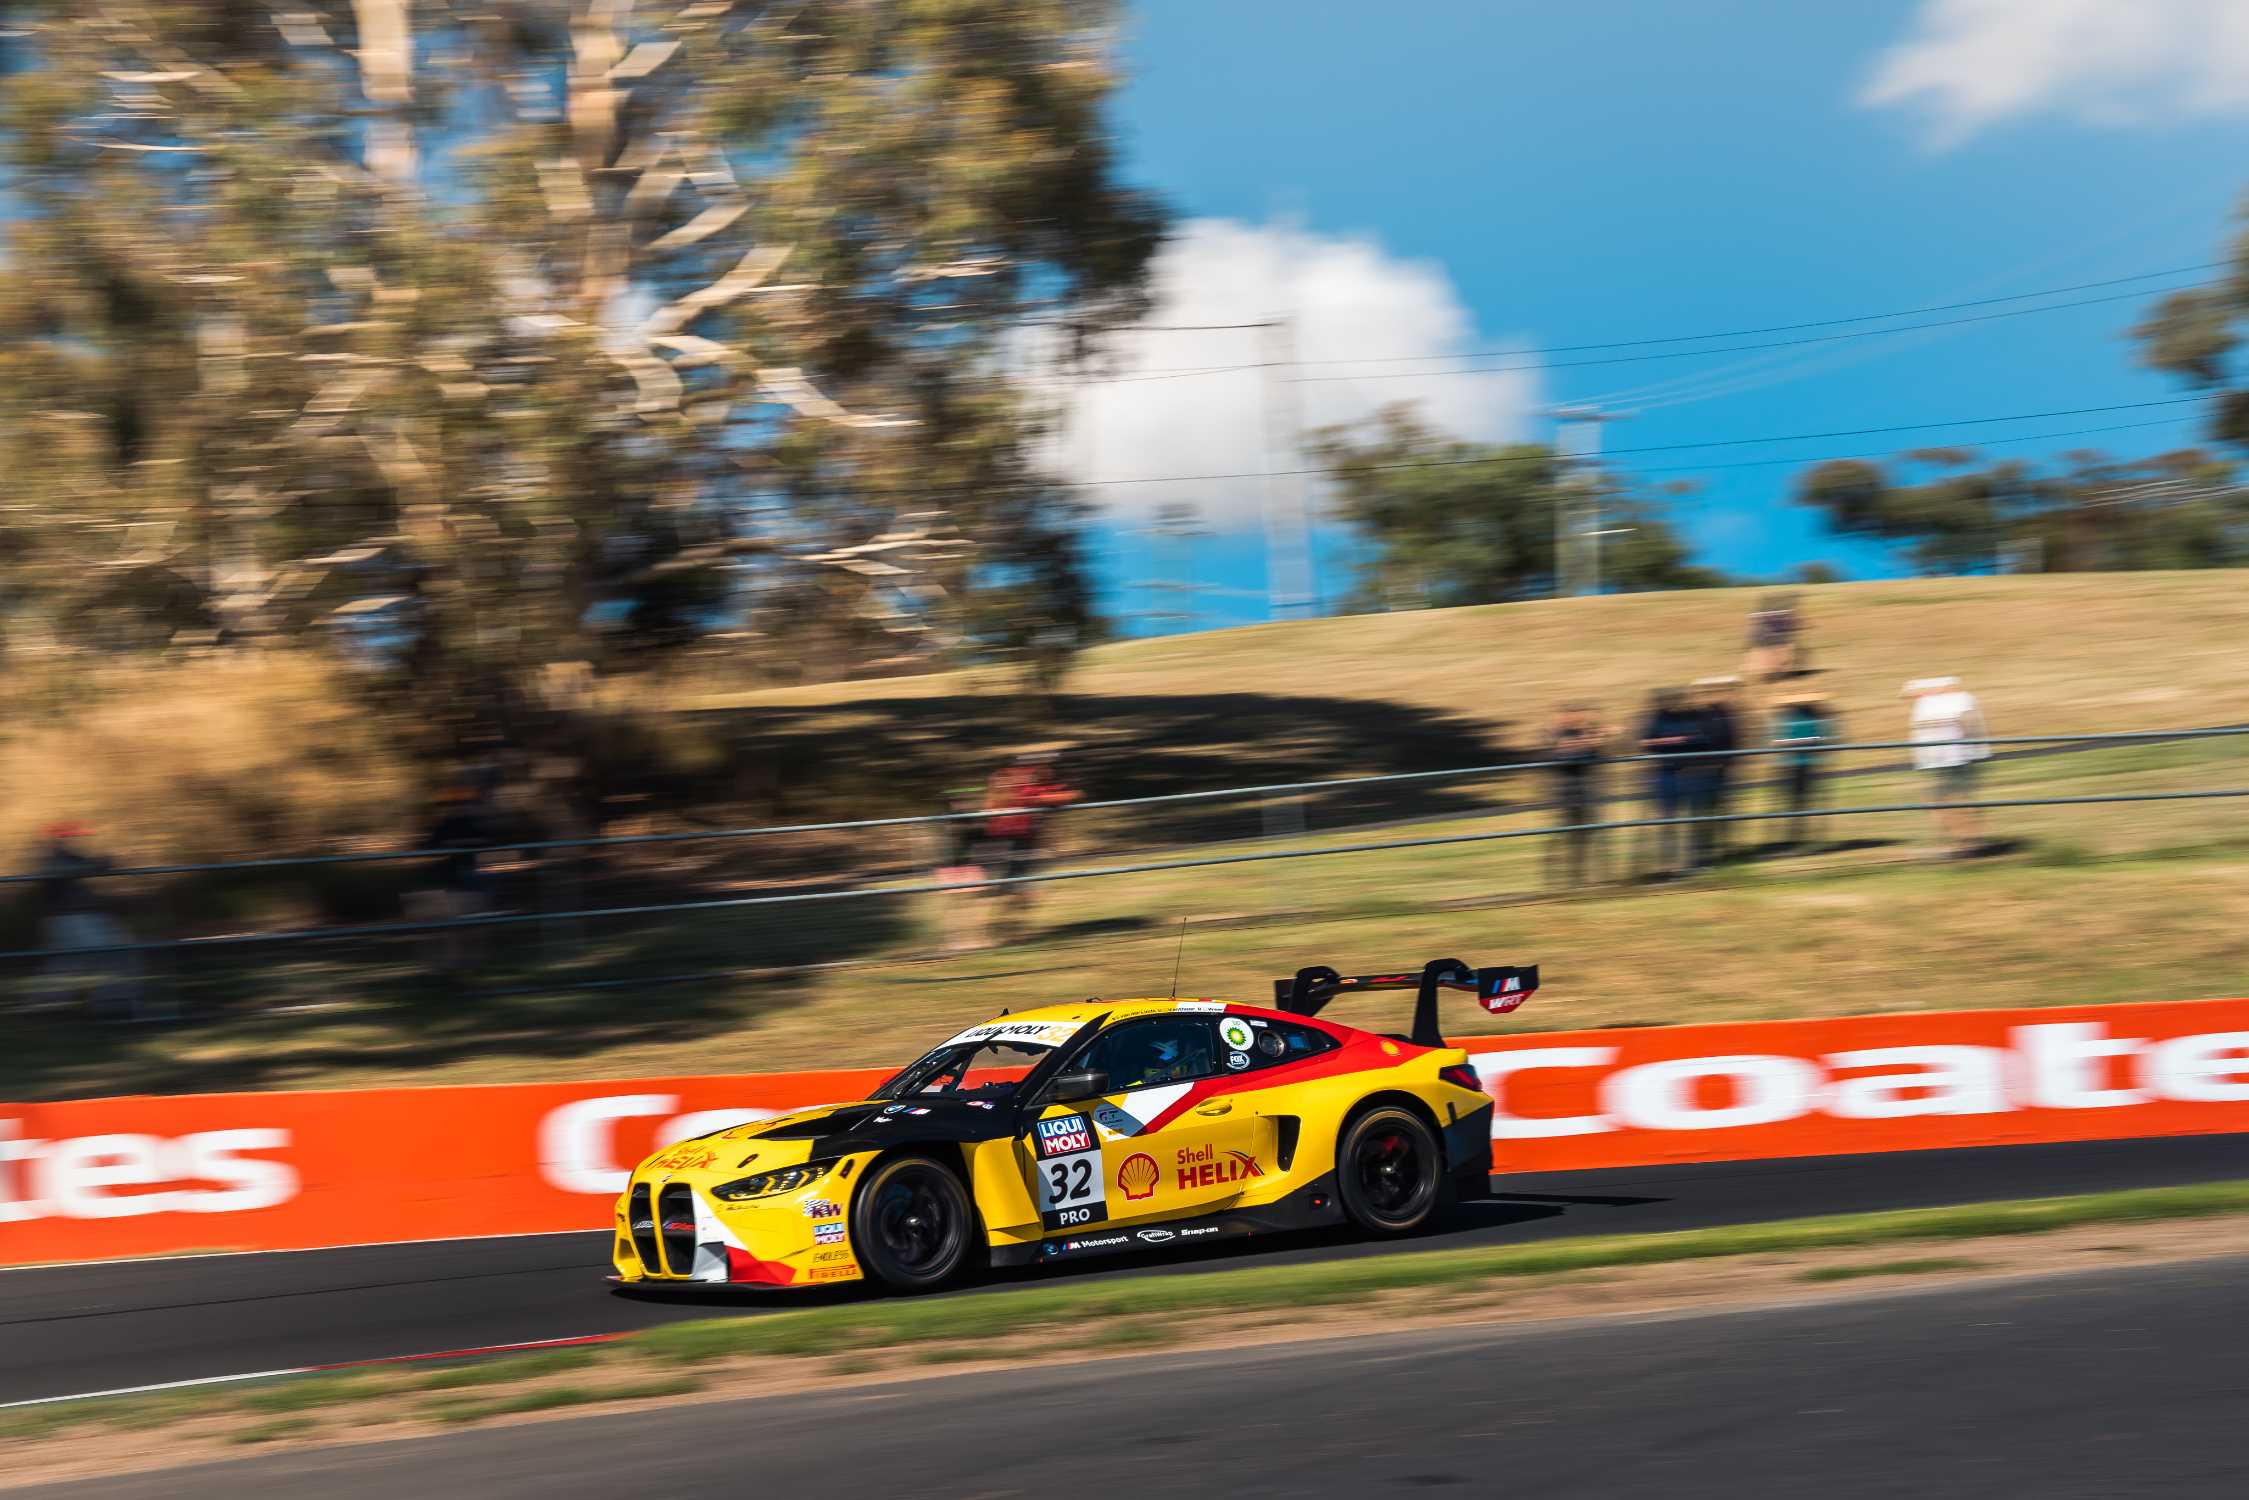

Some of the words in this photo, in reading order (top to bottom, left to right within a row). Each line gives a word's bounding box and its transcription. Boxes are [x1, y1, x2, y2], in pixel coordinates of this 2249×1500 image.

[1041, 1118, 1083, 1138] LIQUI
[1045, 1132, 1087, 1153] MOLY
[1177, 1143, 1213, 1165] Shell
[1049, 1158, 1092, 1204] 32
[1177, 1152, 1263, 1190] HELIX
[811, 1203, 843, 1218] KW
[1060, 1208, 1090, 1225] PRO
[1081, 1236, 1129, 1248] Motorsport
